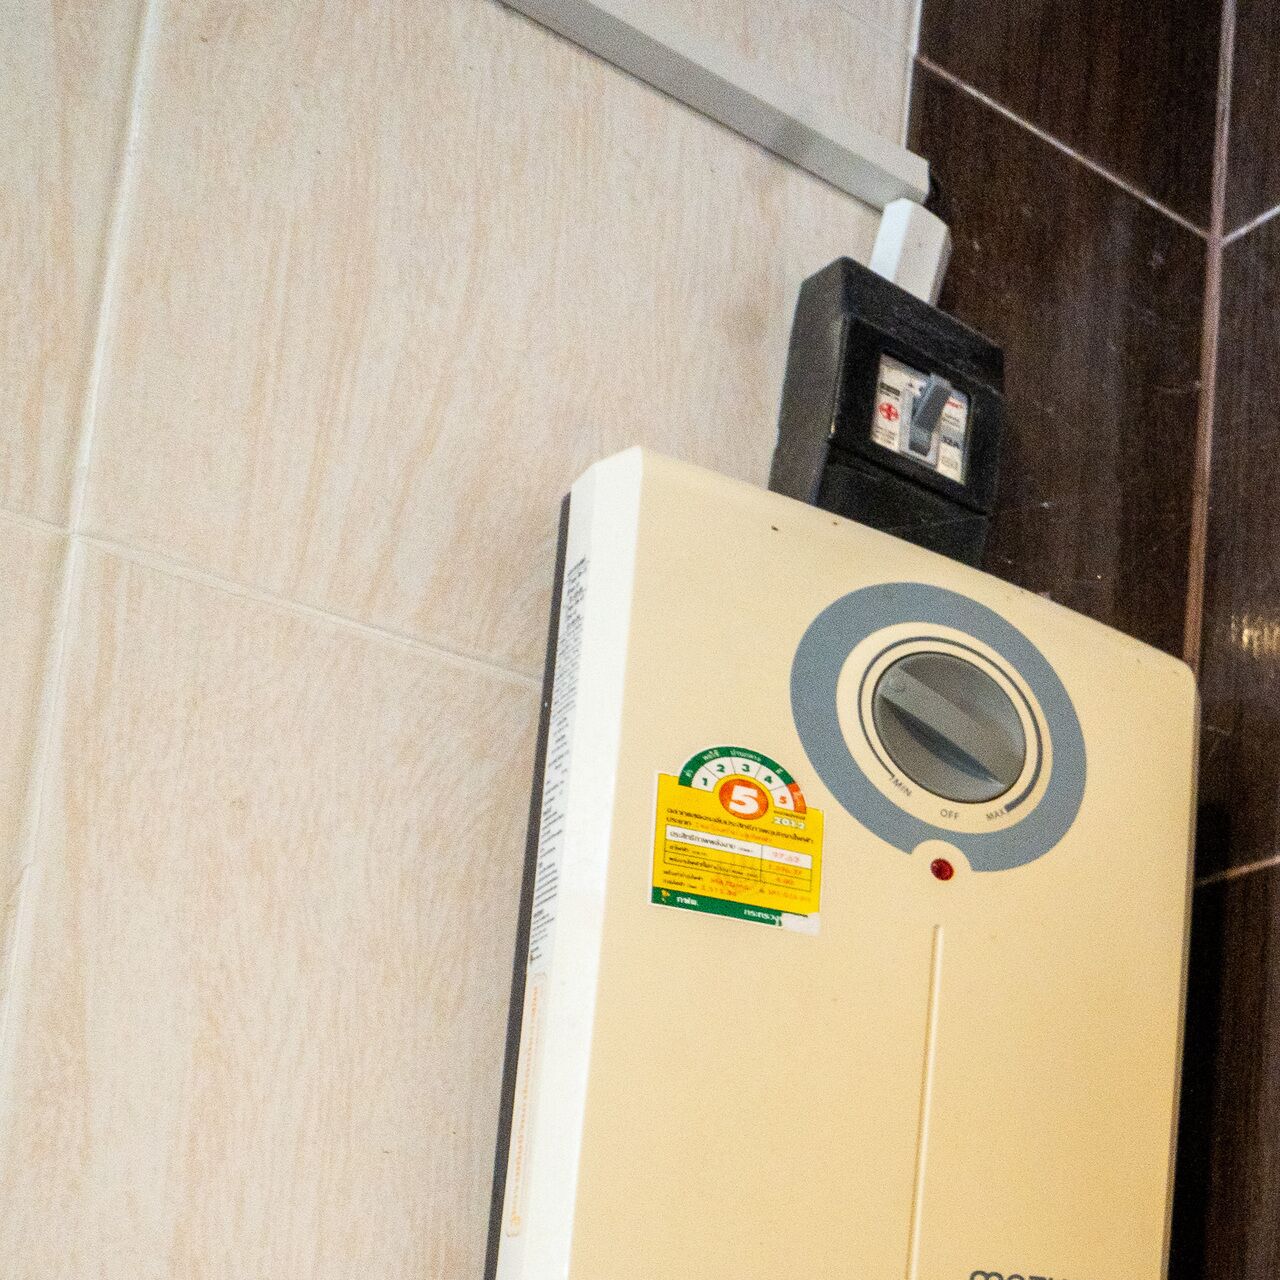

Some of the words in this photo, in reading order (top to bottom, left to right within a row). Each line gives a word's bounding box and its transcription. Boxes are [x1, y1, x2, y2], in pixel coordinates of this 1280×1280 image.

[702, 777, 708, 786] 1
[716, 764, 725, 773] 2
[741, 764, 750, 772] 3
[764, 775, 772, 784] 4
[779, 796, 787, 804] 5
[890, 776, 912, 797] MIN
[728, 785, 760, 814] 5
[940, 809, 959, 820] OFF
[986, 808, 1006, 821] MAX
